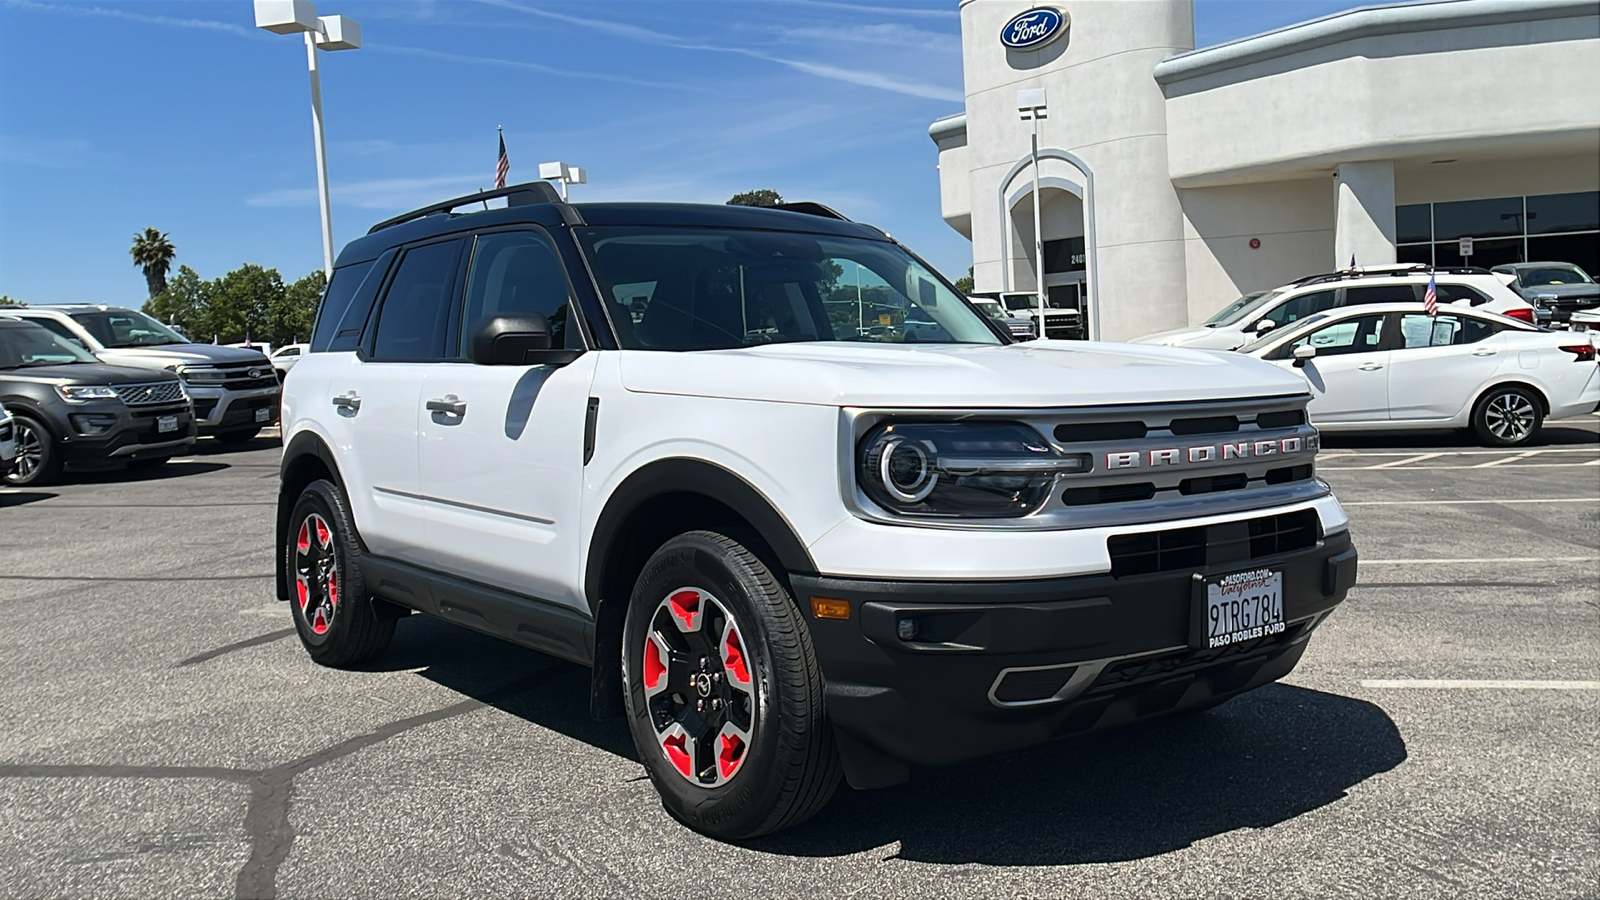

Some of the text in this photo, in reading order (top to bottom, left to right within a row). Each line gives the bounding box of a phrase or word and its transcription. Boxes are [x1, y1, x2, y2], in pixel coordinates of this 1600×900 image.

[1011, 14, 1049, 43] Ford
[1106, 437, 1301, 470] BRONCO
[1221, 578, 1271, 598] California
[1210, 592, 1280, 637] 9TRG784
[1209, 621, 1286, 648] PASO ROBLES FORD
